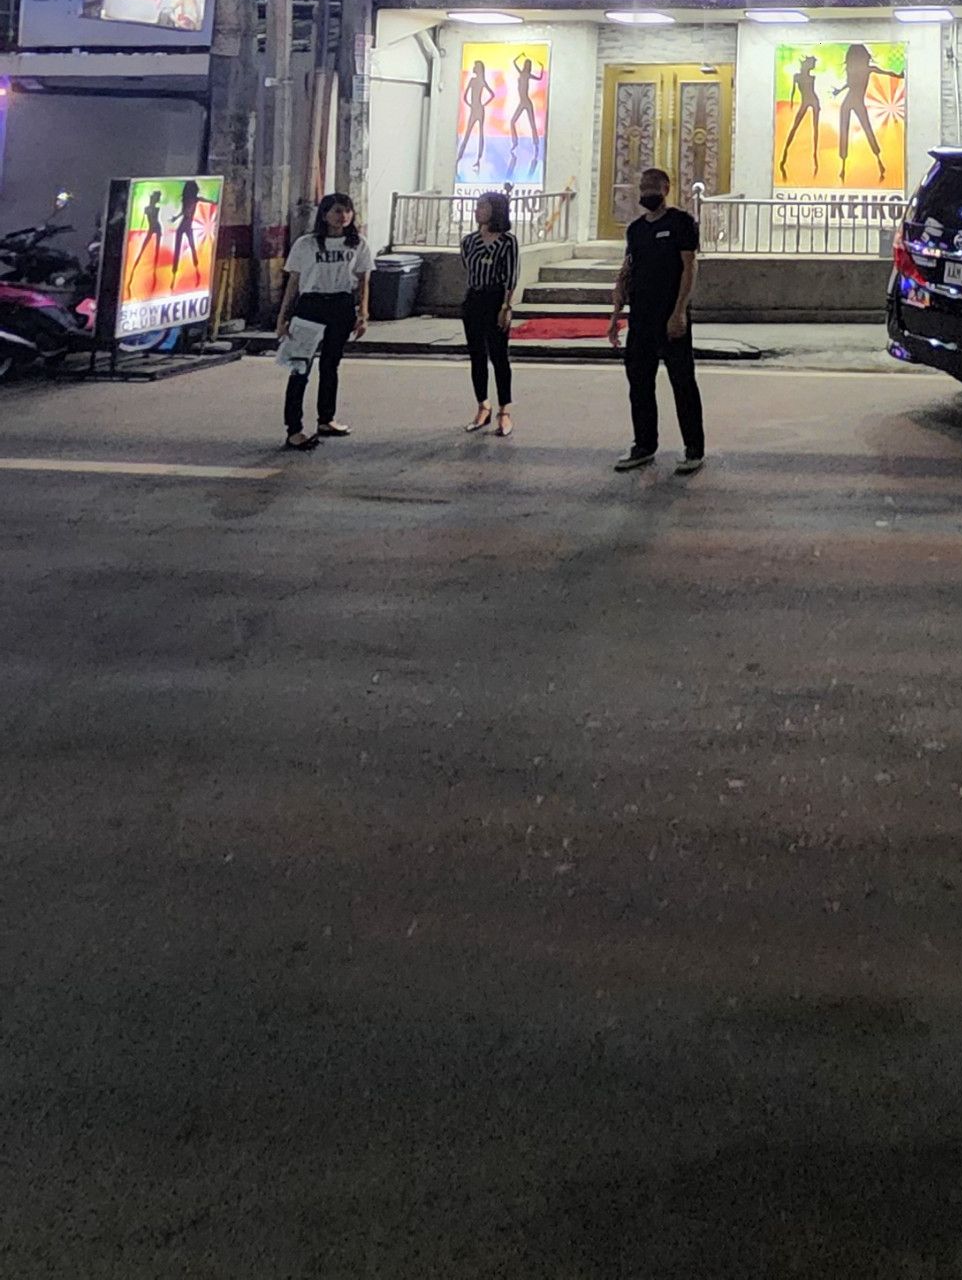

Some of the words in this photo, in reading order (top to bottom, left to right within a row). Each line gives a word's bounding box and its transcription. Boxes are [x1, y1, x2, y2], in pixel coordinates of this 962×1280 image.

[776, 192, 828, 203] SHOW
[829, 194, 904, 220] KEIKO
[776, 206, 824, 219] CLUB
[315, 249, 354, 263] KEIKO
[120, 306, 160, 318] SHOW
[160, 296, 209, 324] KEIKO
[121, 315, 158, 332] CLUB
